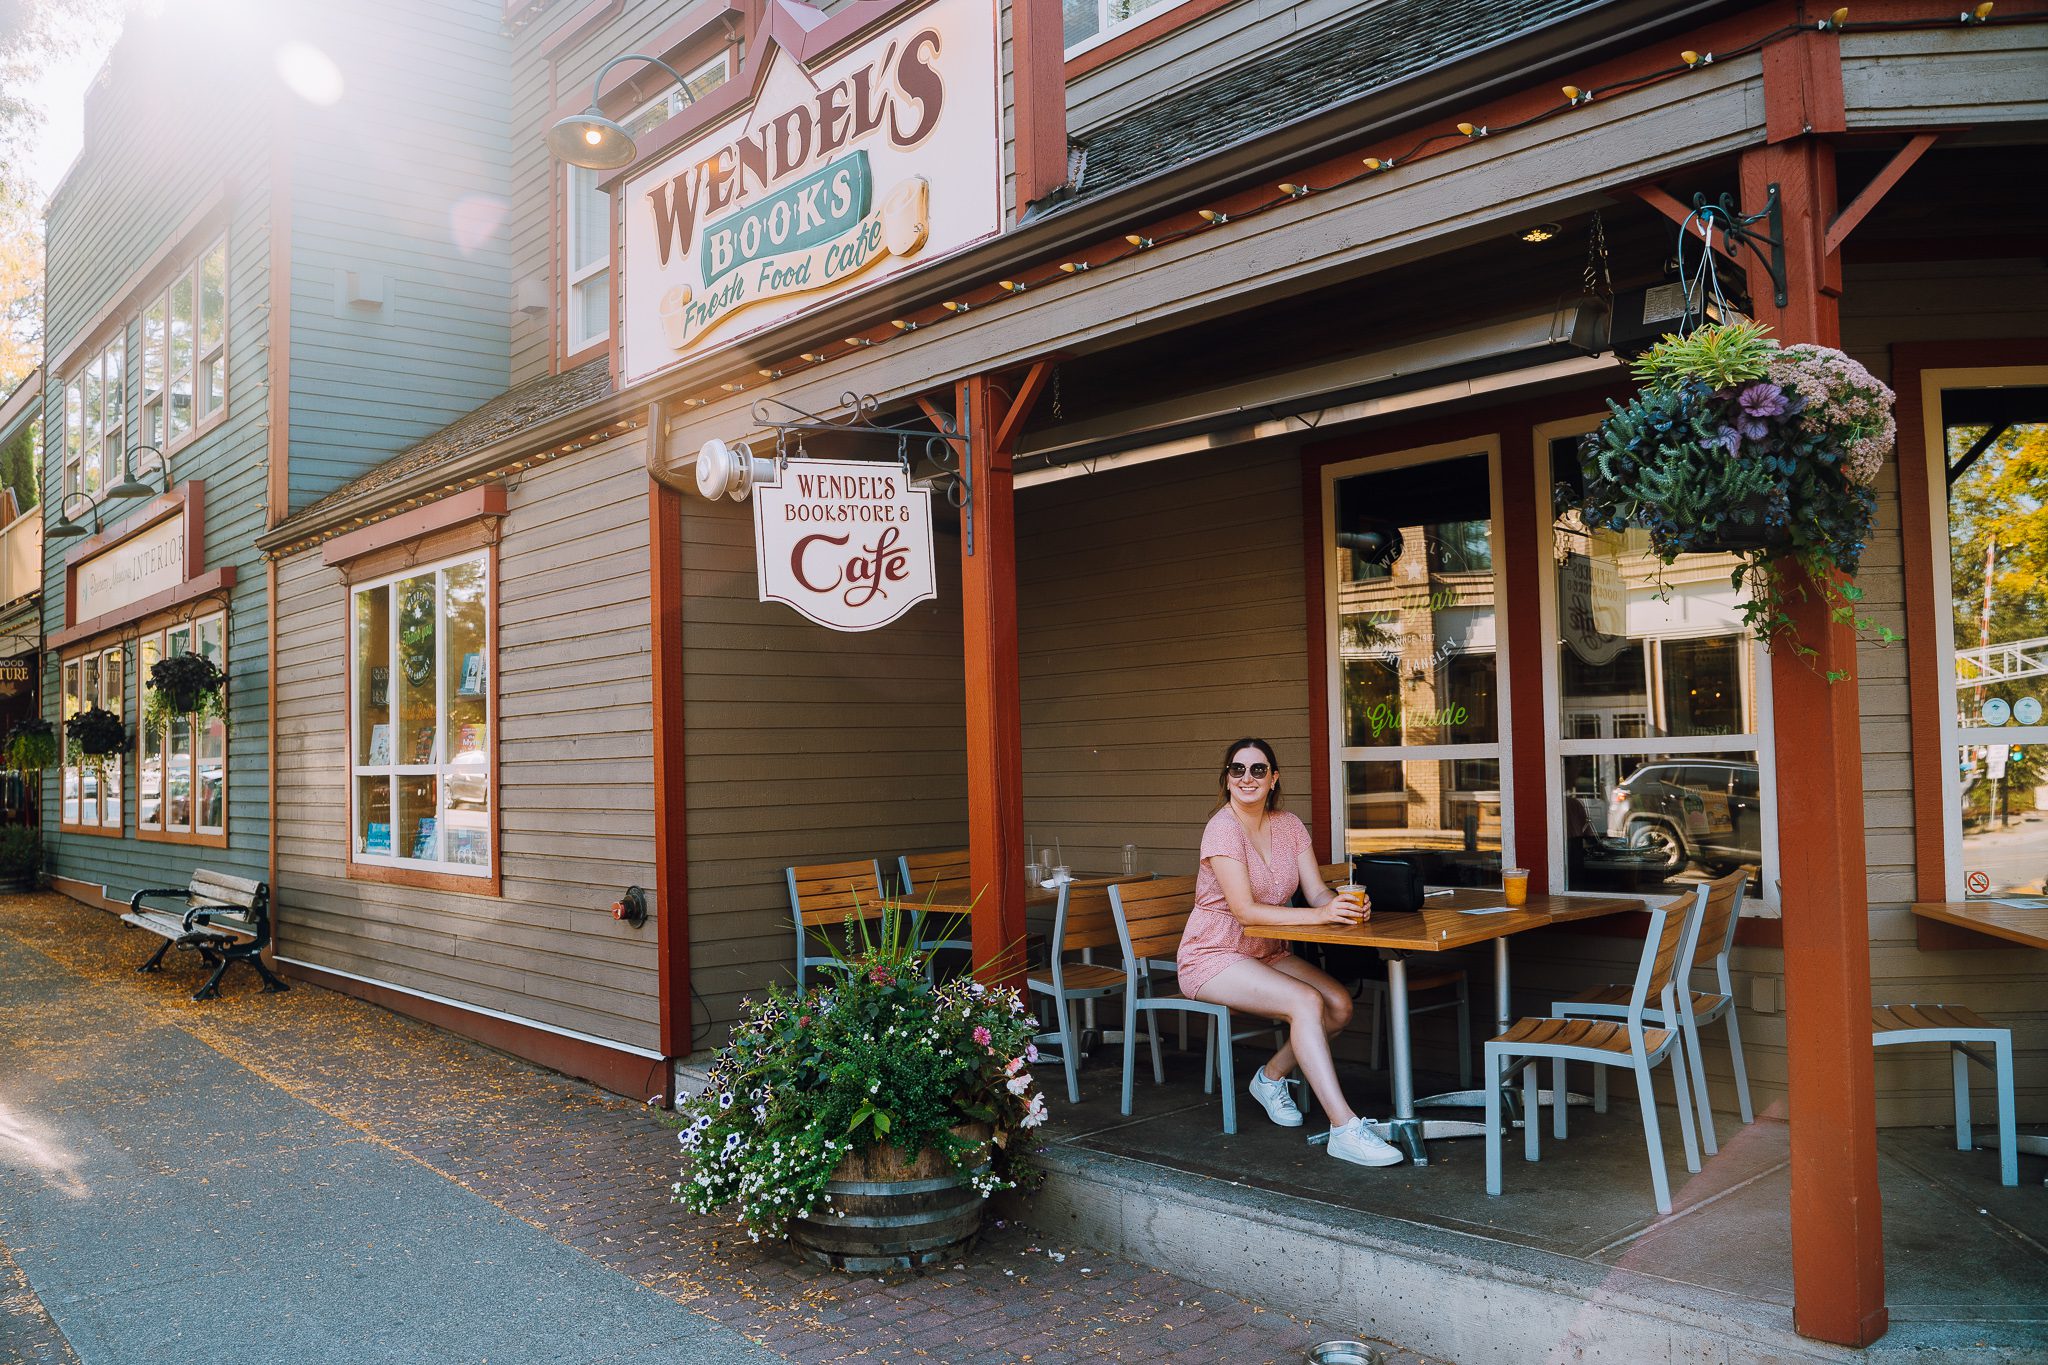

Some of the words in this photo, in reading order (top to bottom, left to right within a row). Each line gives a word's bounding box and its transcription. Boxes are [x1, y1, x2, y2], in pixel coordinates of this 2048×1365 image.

[647, 29, 943, 266] WENDEL'S
[709, 169, 851, 277] BOOKS
[682, 273, 745, 339] Fresh
[757, 256, 812, 293] Food
[824, 210, 883, 269] Café
[797, 474, 896, 500] WENDEL'S
[785, 503, 895, 522] BOOKSTORE
[790, 526, 911, 608] Cafe
[1378, 539, 1452, 570] WENDEL'S
[1406, 636, 1458, 672] LANGLEY
[1366, 702, 1469, 738] Gratitude
